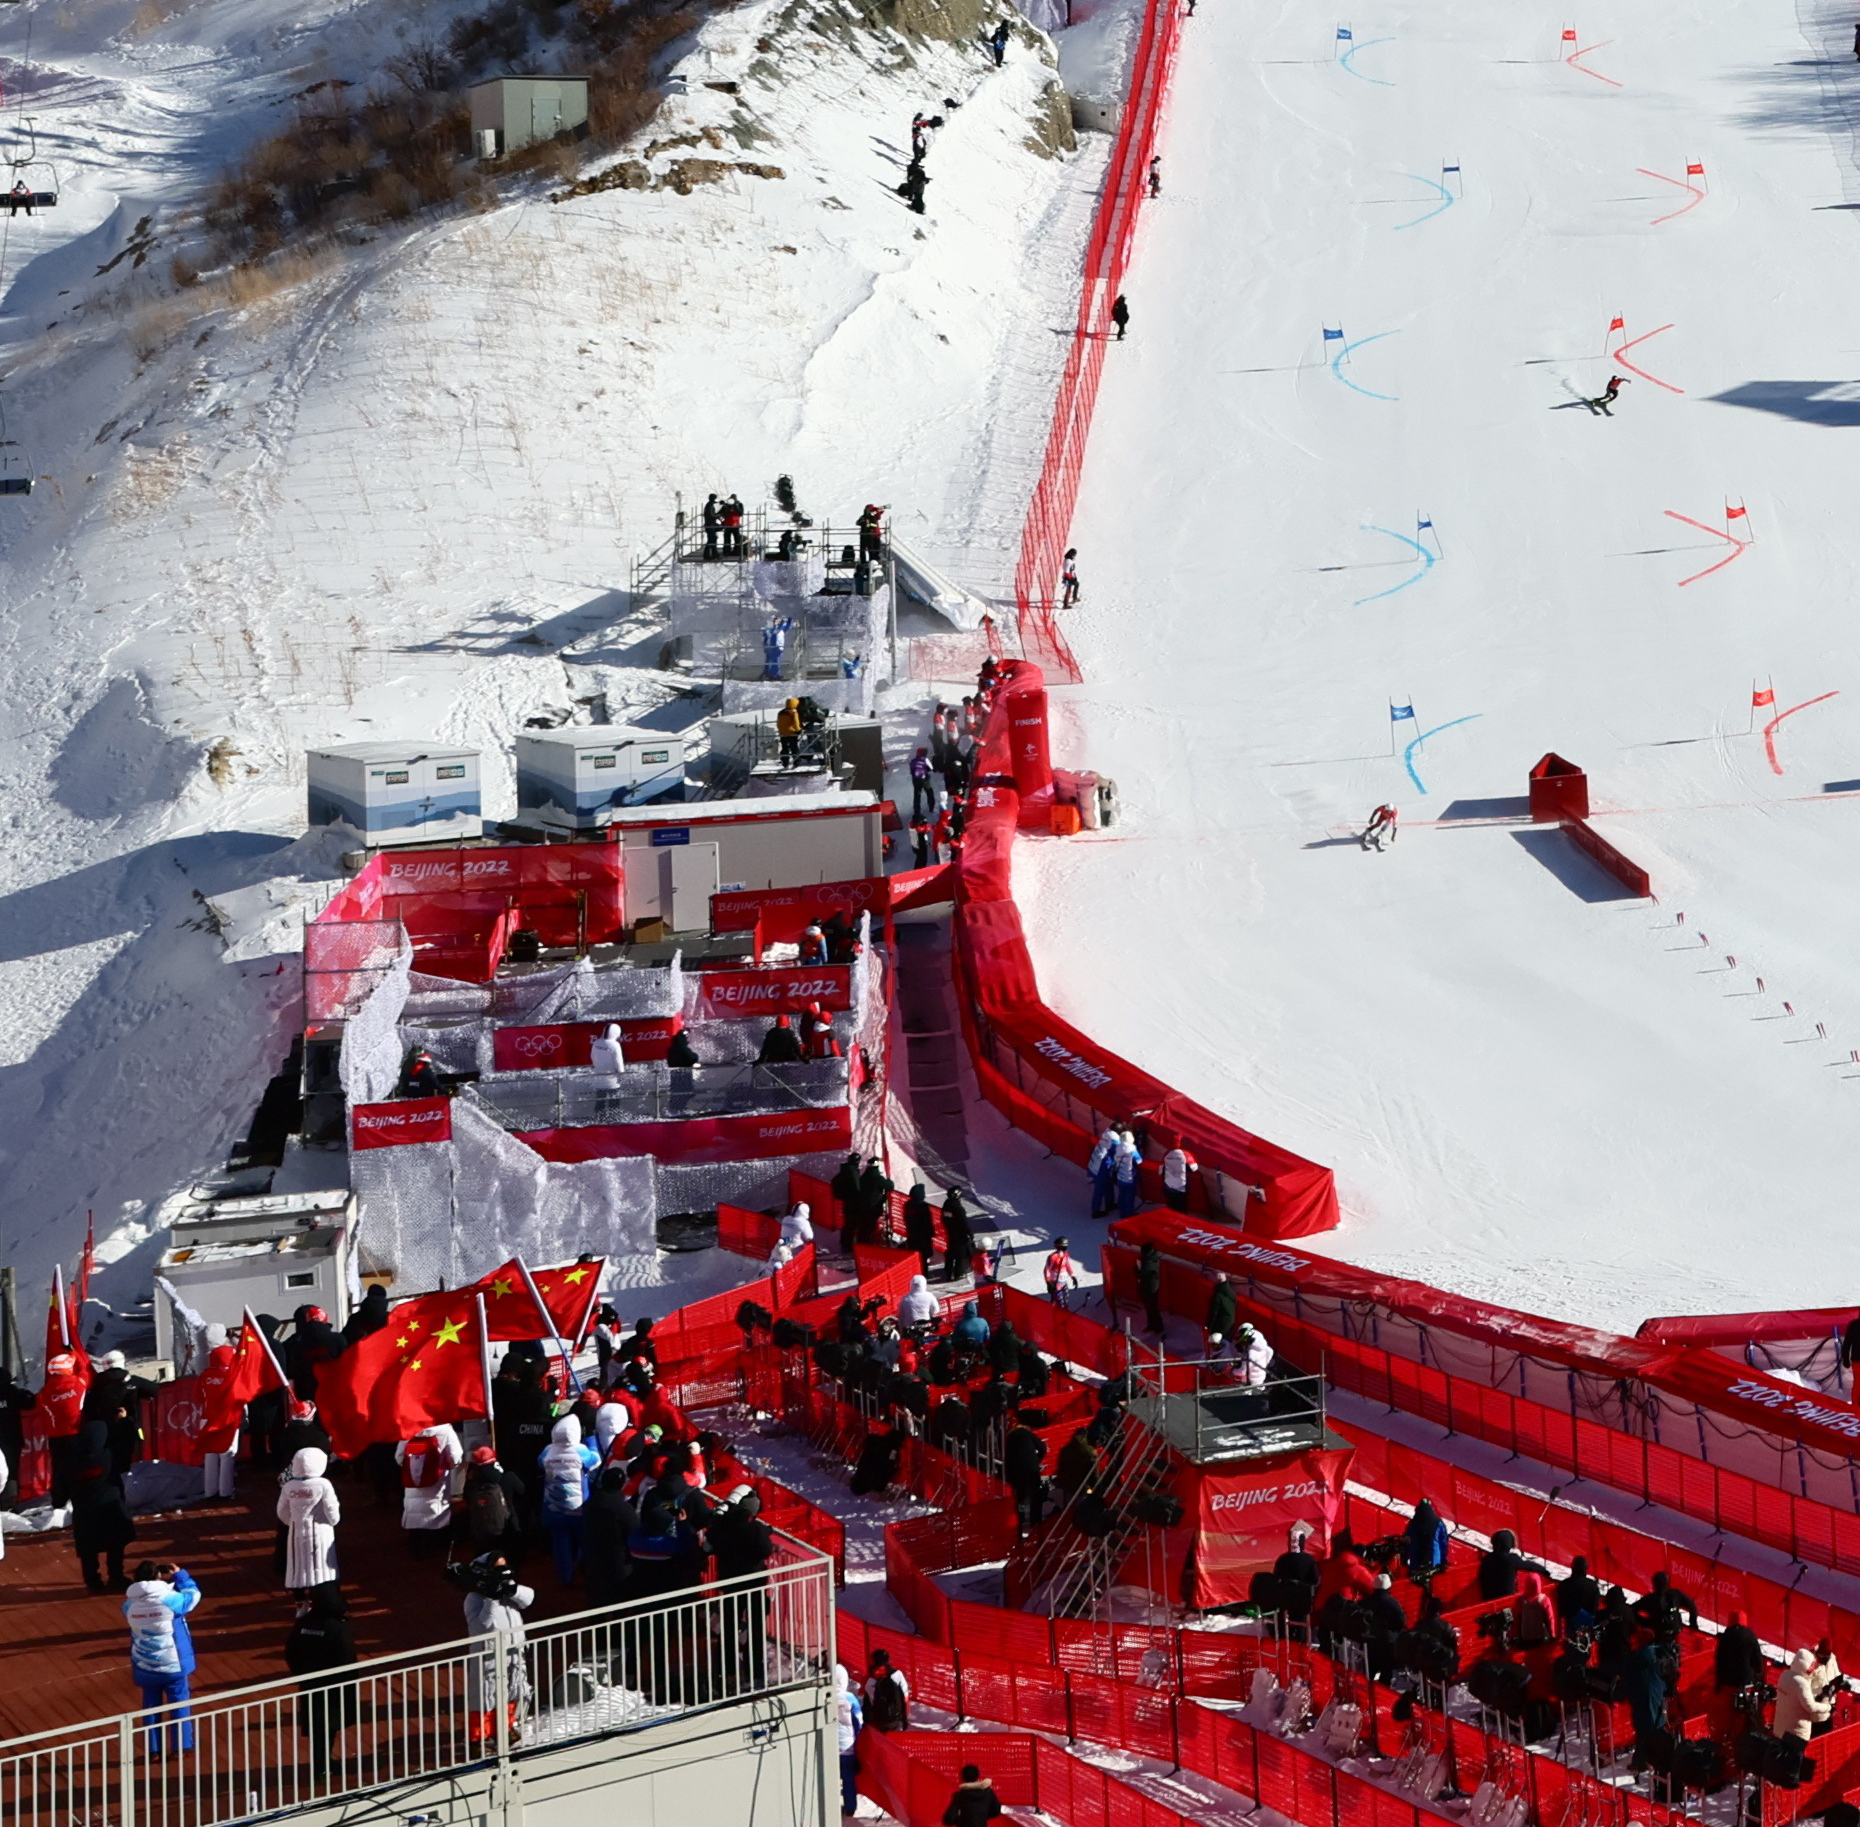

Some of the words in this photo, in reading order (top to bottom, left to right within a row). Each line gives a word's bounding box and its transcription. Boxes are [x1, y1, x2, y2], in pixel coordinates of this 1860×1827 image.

[390, 862, 457, 882] BEIJING
[463, 860, 512, 876] 2022
[712, 983, 780, 1005] BEIJING
[787, 979, 842, 997] 2022
[636, 1029, 670, 1041] 2022
[358, 1114, 406, 1129] BEIJING
[409, 1110, 445, 1124] 2022
[760, 1123, 803, 1138] BEIJING
[806, 1121, 841, 1133] 2022
[1176, 1227, 1238, 1250] 2022
[1227, 1244, 1312, 1272] BEIJING
[52, 1389, 77, 1402] CHINA
[1727, 1377, 1795, 1408] 2022
[519, 1423, 545, 1435] CHINA
[289, 1488, 313, 1499] CHINA
[1212, 1486, 1278, 1512] BEIJING
